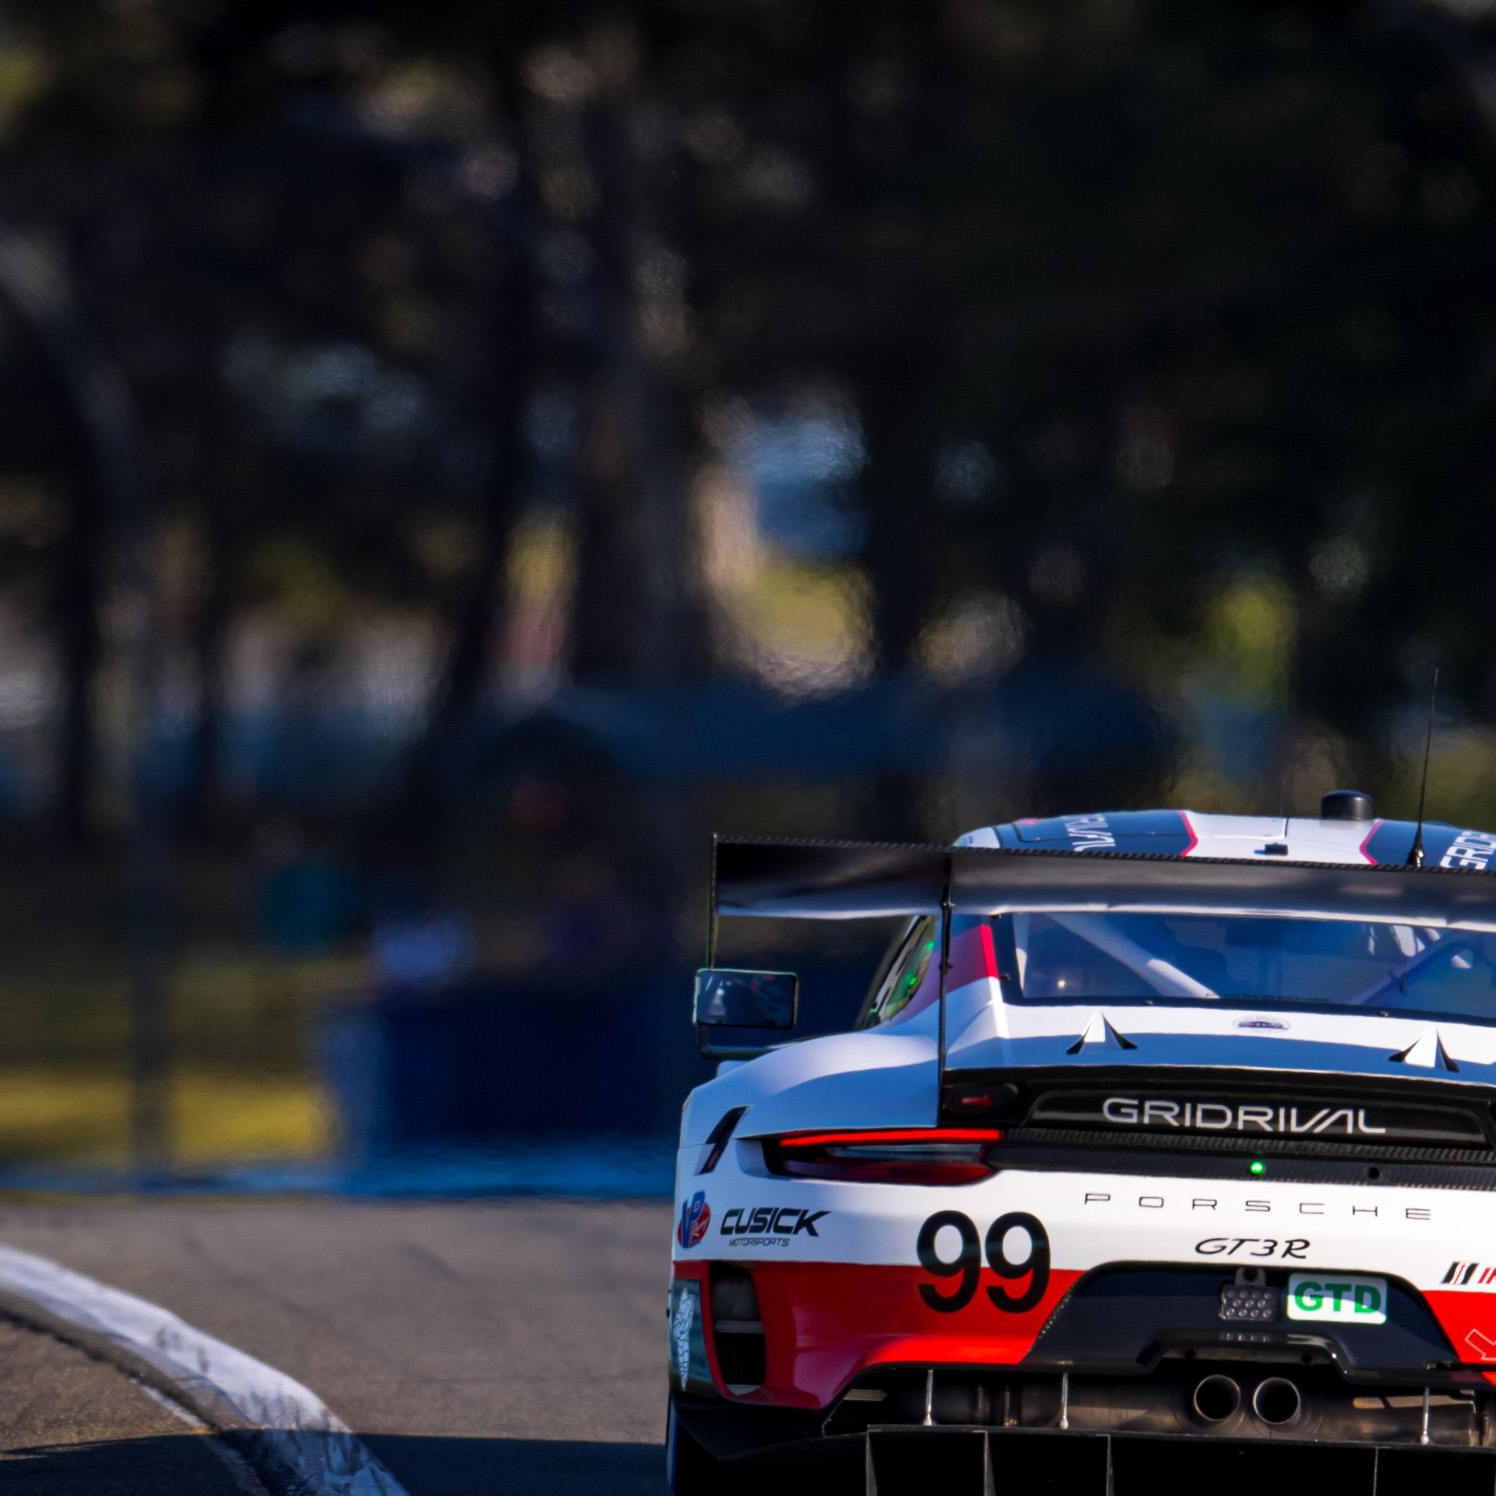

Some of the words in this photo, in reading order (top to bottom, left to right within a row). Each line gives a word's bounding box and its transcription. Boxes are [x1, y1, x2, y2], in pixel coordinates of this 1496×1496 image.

[1103, 1098, 1386, 1134] GRIDRIVAL
[720, 1207, 832, 1237] CUSICK
[1084, 1193, 1431, 1220] PORSCHE
[729, 1237, 791, 1247] MOTORSPORTS
[916, 1210, 1051, 1314] 99
[1294, 1281, 1382, 1314] GTD
